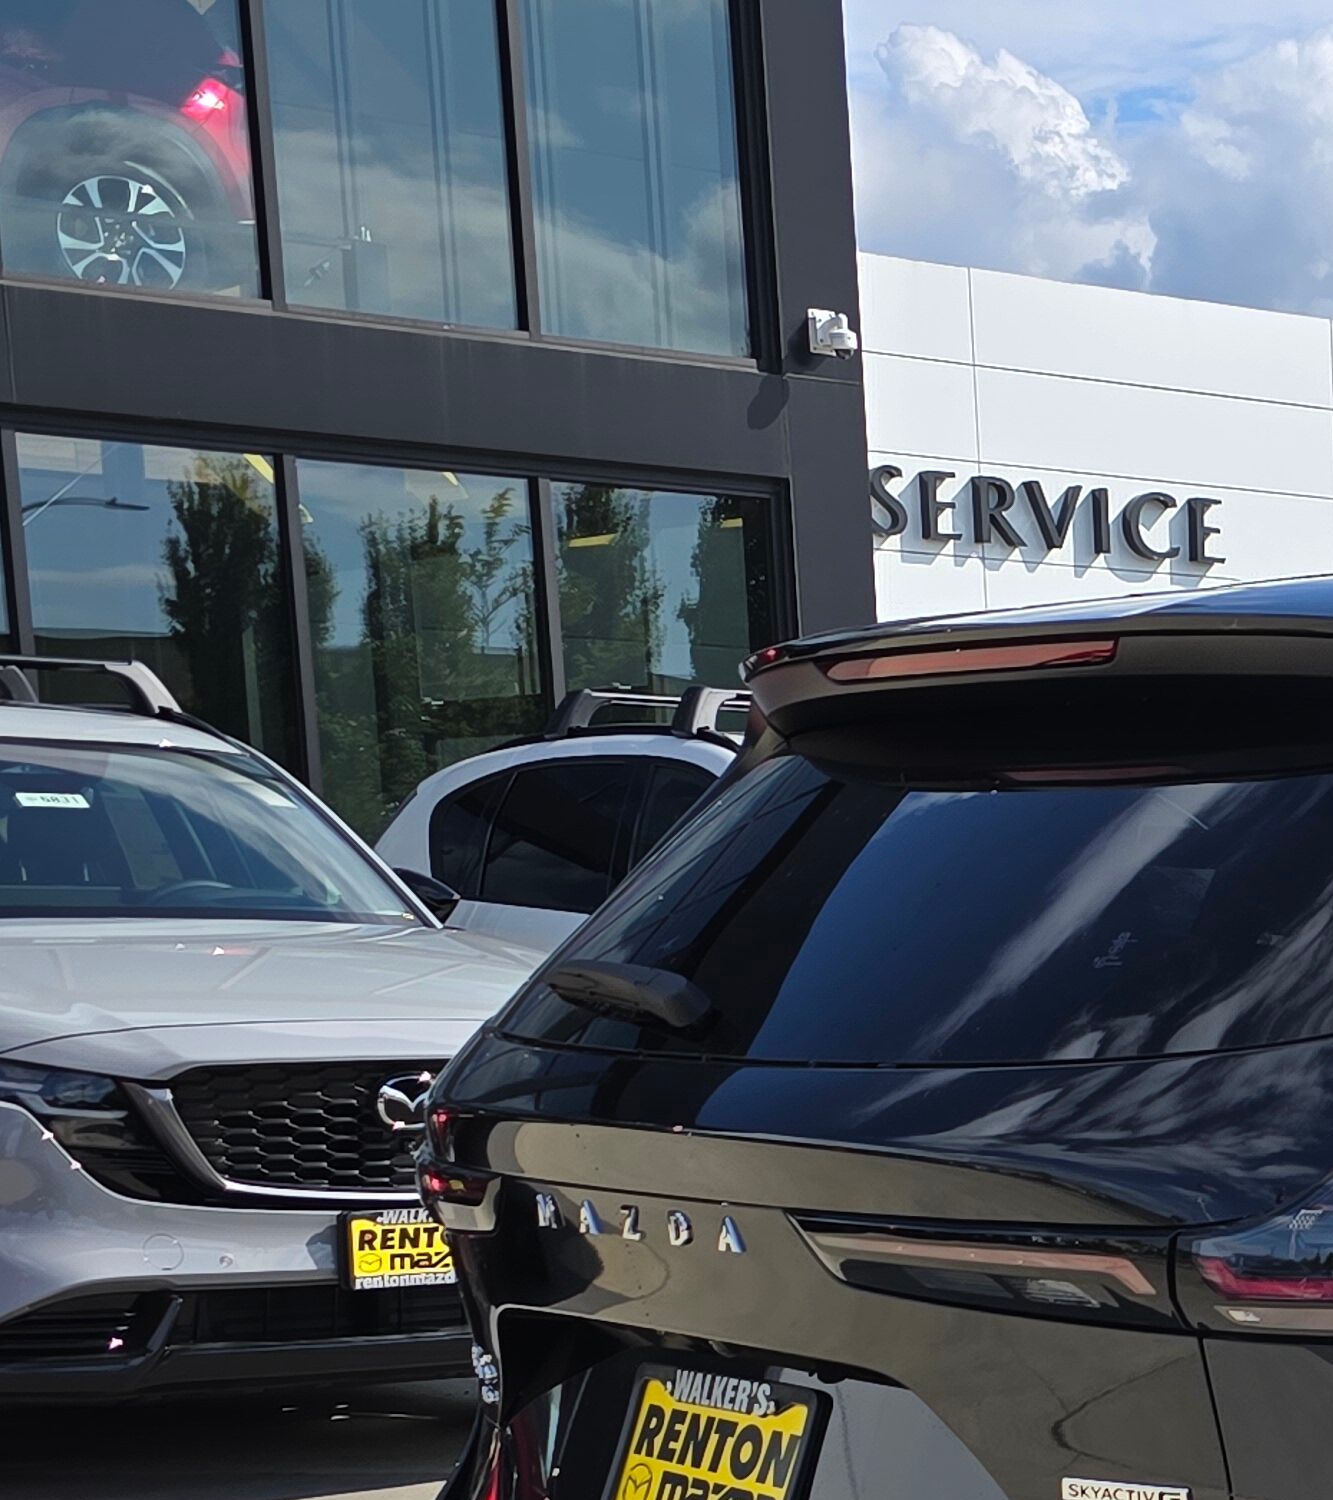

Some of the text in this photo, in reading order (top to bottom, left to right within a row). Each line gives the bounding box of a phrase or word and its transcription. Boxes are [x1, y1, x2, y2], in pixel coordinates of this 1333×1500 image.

[870, 465, 1226, 565] SERVICE
[382, 1208, 434, 1224] WALK
[536, 1194, 747, 1254] MAZDA
[674, 1369, 772, 1416] WALKER'S
[633, 1403, 801, 1489] RENTON
